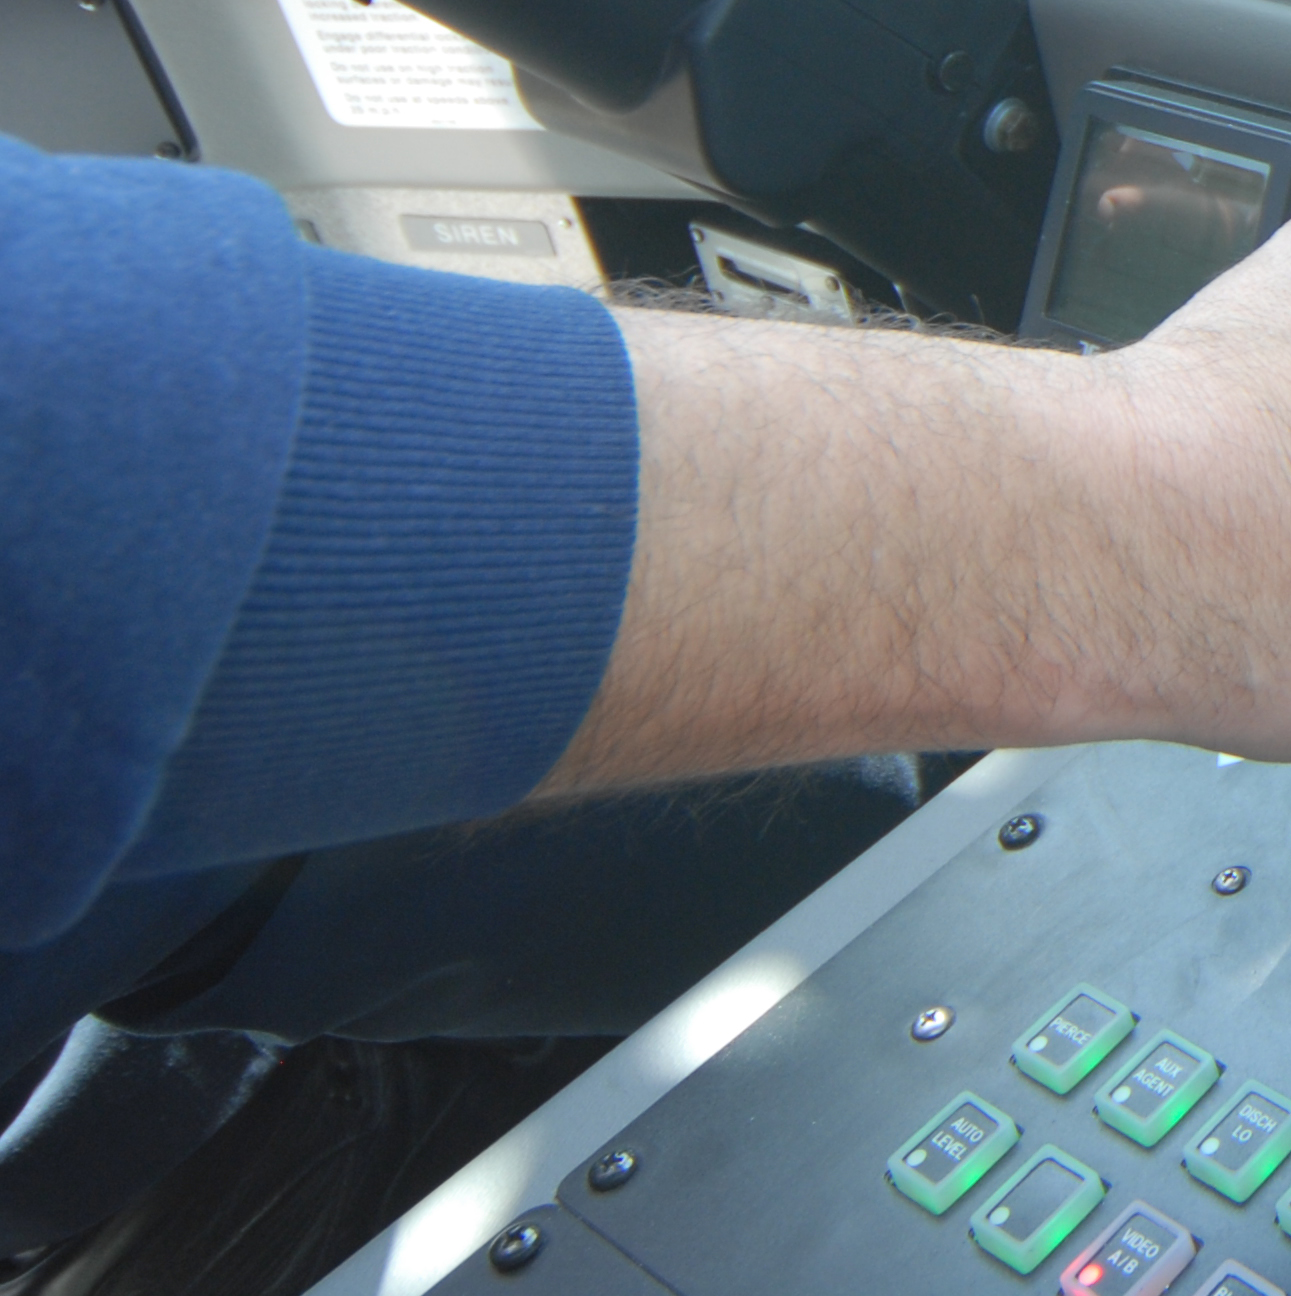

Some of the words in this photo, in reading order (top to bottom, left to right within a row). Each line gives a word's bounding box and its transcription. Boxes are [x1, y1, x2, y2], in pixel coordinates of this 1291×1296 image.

[433, 222, 519, 246] SIREN
[1050, 1016, 1092, 1047] PIERCE
[1155, 1056, 1184, 1079] AUX
[1132, 1068, 1175, 1100] AGENT
[950, 1116, 985, 1145] AUTO
[1238, 1103, 1278, 1134] DISCH
[930, 1131, 968, 1162] LEVEL
[1231, 1124, 1253, 1144] LO
[1120, 1228, 1160, 1259] VIDEO
[1107, 1249, 1139, 1275] A/B
